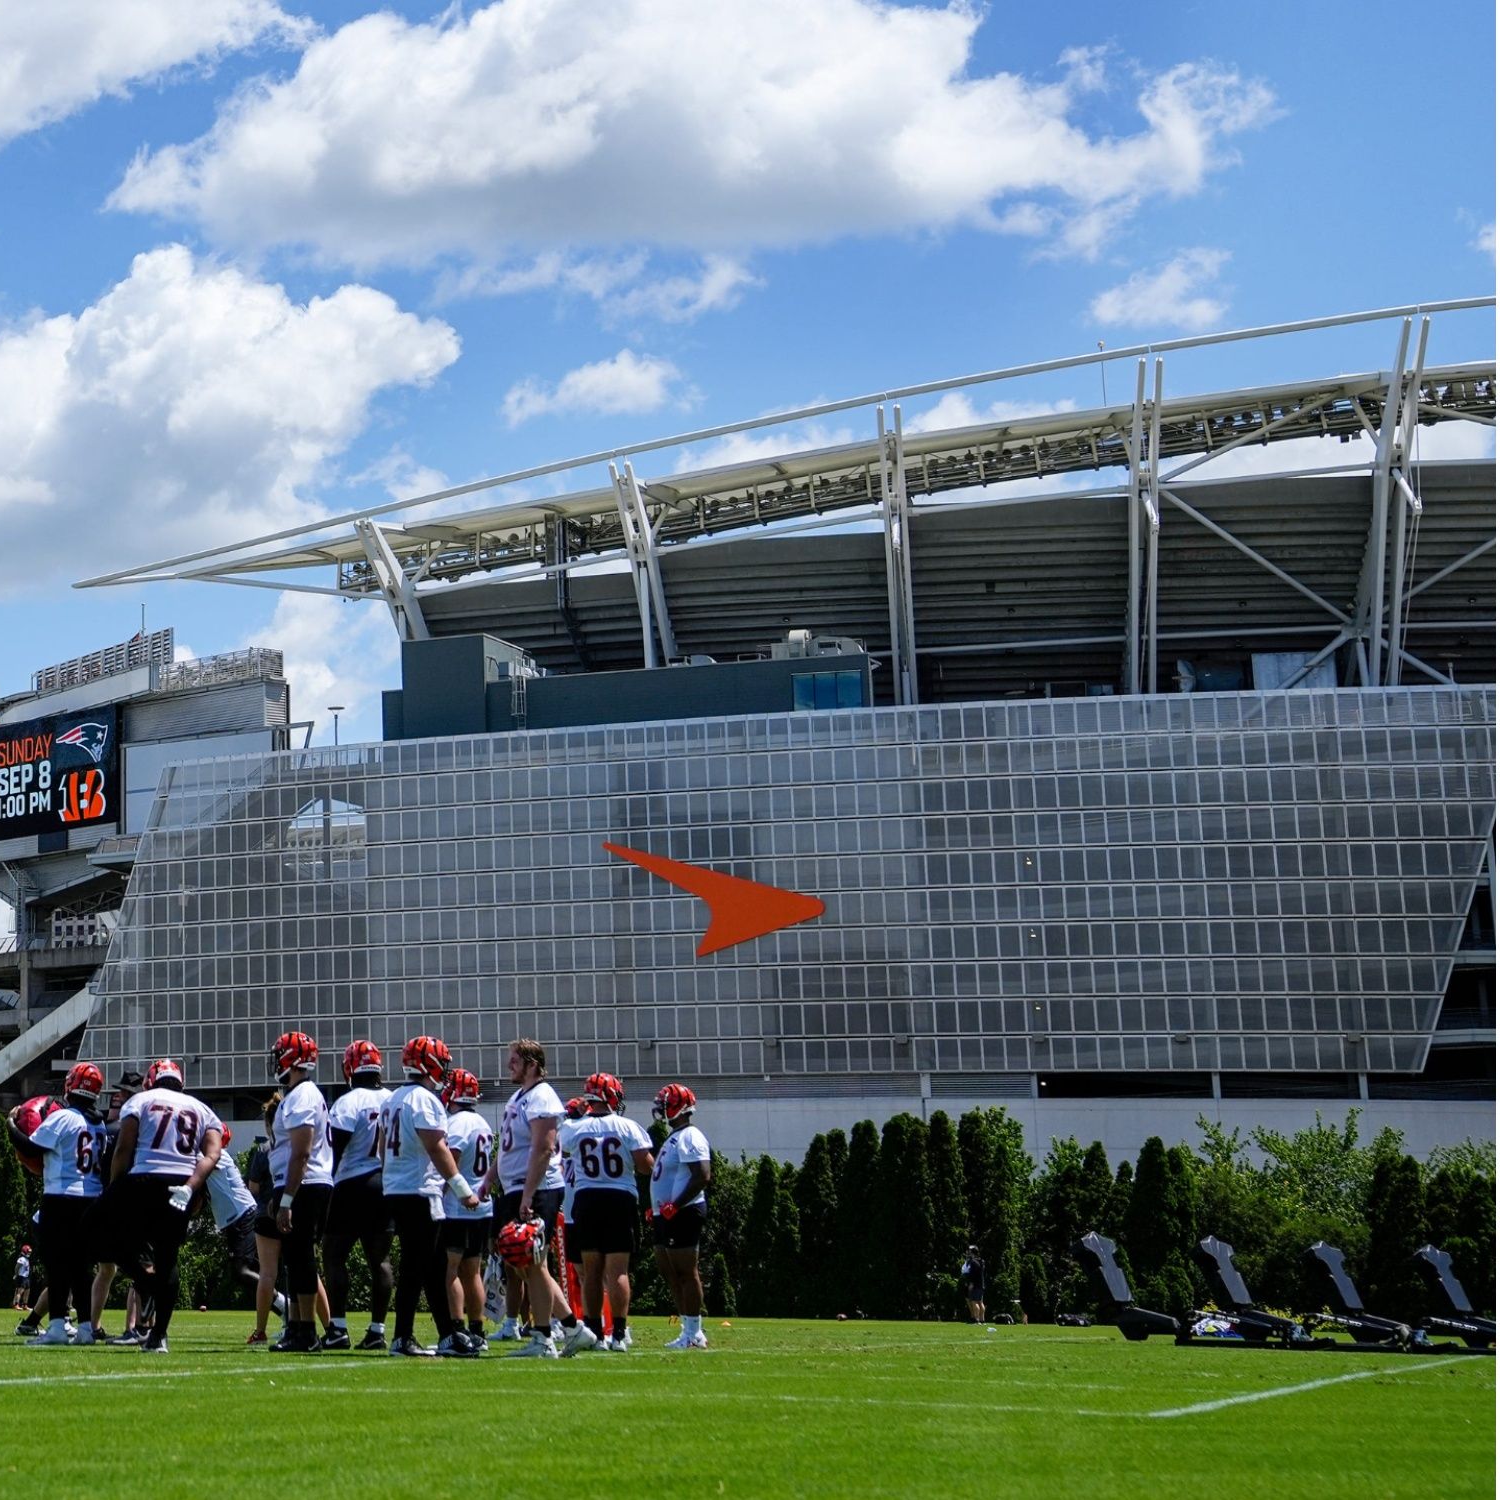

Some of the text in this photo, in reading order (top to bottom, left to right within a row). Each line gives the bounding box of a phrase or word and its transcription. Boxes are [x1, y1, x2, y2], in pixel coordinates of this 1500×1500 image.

[38, 760, 51, 789] 8
[29, 789, 51, 814] PM
[150, 1104, 198, 1154] 79
[579, 1137, 624, 1179] 66
